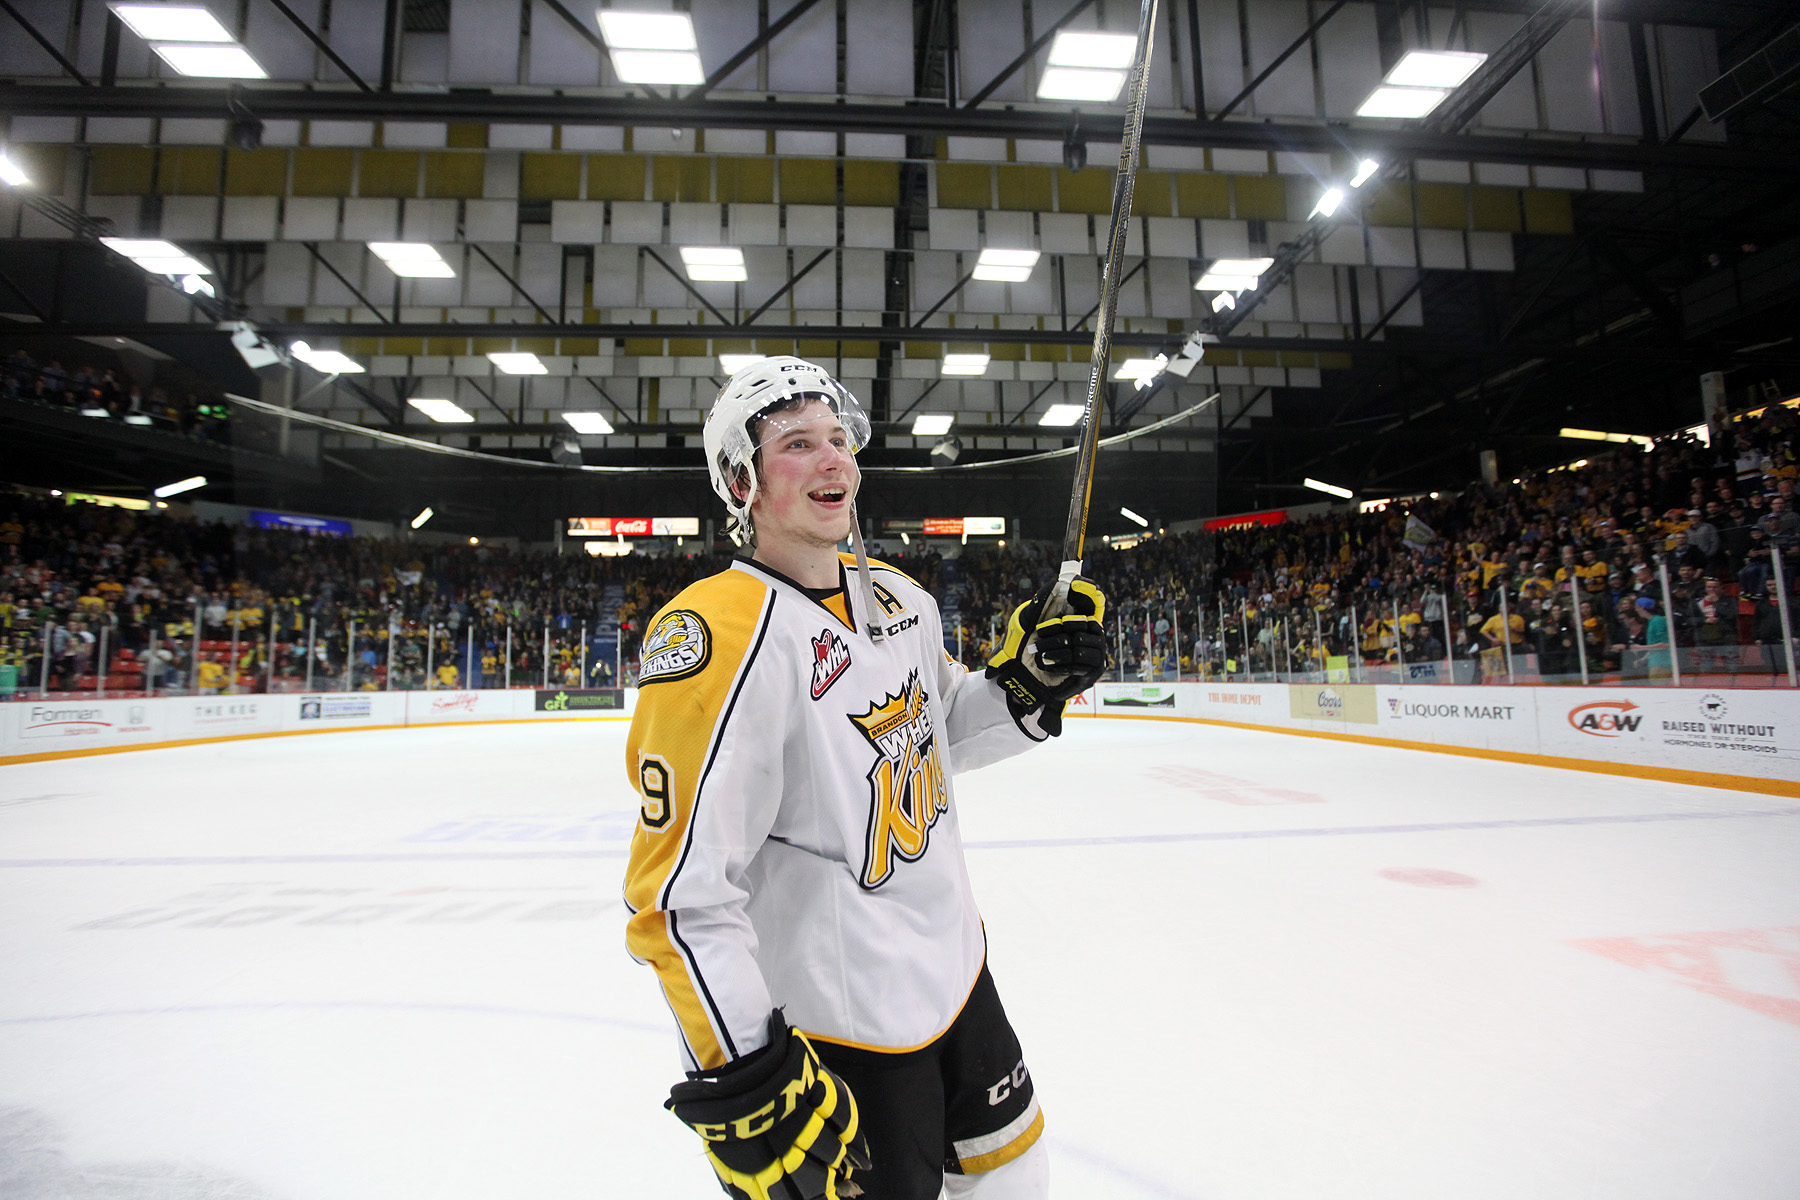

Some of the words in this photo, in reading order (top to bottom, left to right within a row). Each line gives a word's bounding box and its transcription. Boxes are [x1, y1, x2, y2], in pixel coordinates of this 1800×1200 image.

[780, 364, 818, 373] CCM
[871, 577, 907, 619] A
[885, 614, 919, 636] CCM
[815, 639, 850, 689] WHL
[544, 699, 568, 710] GFL
[1004, 680, 1034, 707] CCM
[31, 706, 103, 722] Forman
[1404, 703, 1459, 718] LIQUOR
[1464, 705, 1515, 720] MART
[1579, 713, 1643, 732] A&W
[871, 712, 908, 737] BRANDON
[1662, 720, 1706, 733] RAISED
[1710, 723, 1775, 737] WITHOUT
[1664, 738, 1712, 749] HORMONES
[1730, 743, 1778, 754] STEROIDS
[640, 753, 677, 834] 9
[986, 1059, 1028, 1106] CC
[691, 1051, 816, 1142] CCM
